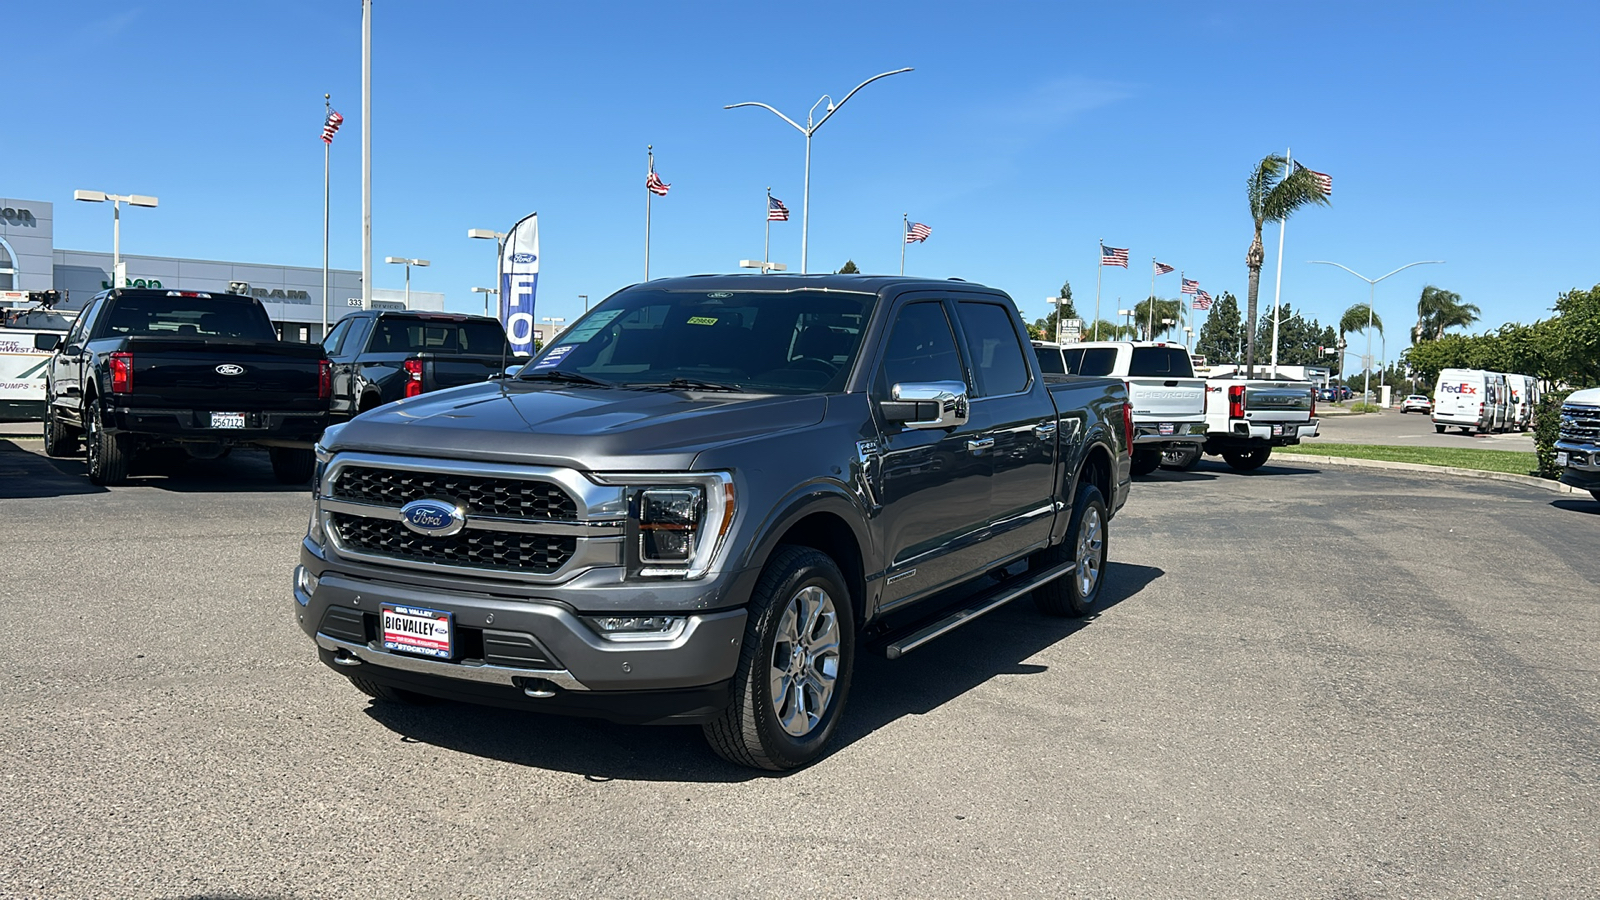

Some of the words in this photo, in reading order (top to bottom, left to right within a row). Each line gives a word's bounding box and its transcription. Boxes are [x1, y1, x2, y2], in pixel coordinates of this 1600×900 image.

[512, 254, 534, 264] Ford
[251, 287, 308, 300] RAM
[507, 274, 535, 357] FO
[218, 365, 241, 375] Ford
[1441, 382, 1477, 395] FedEx
[1136, 391, 1202, 399] CHEVROLET
[408, 608, 433, 617] VALLEY
